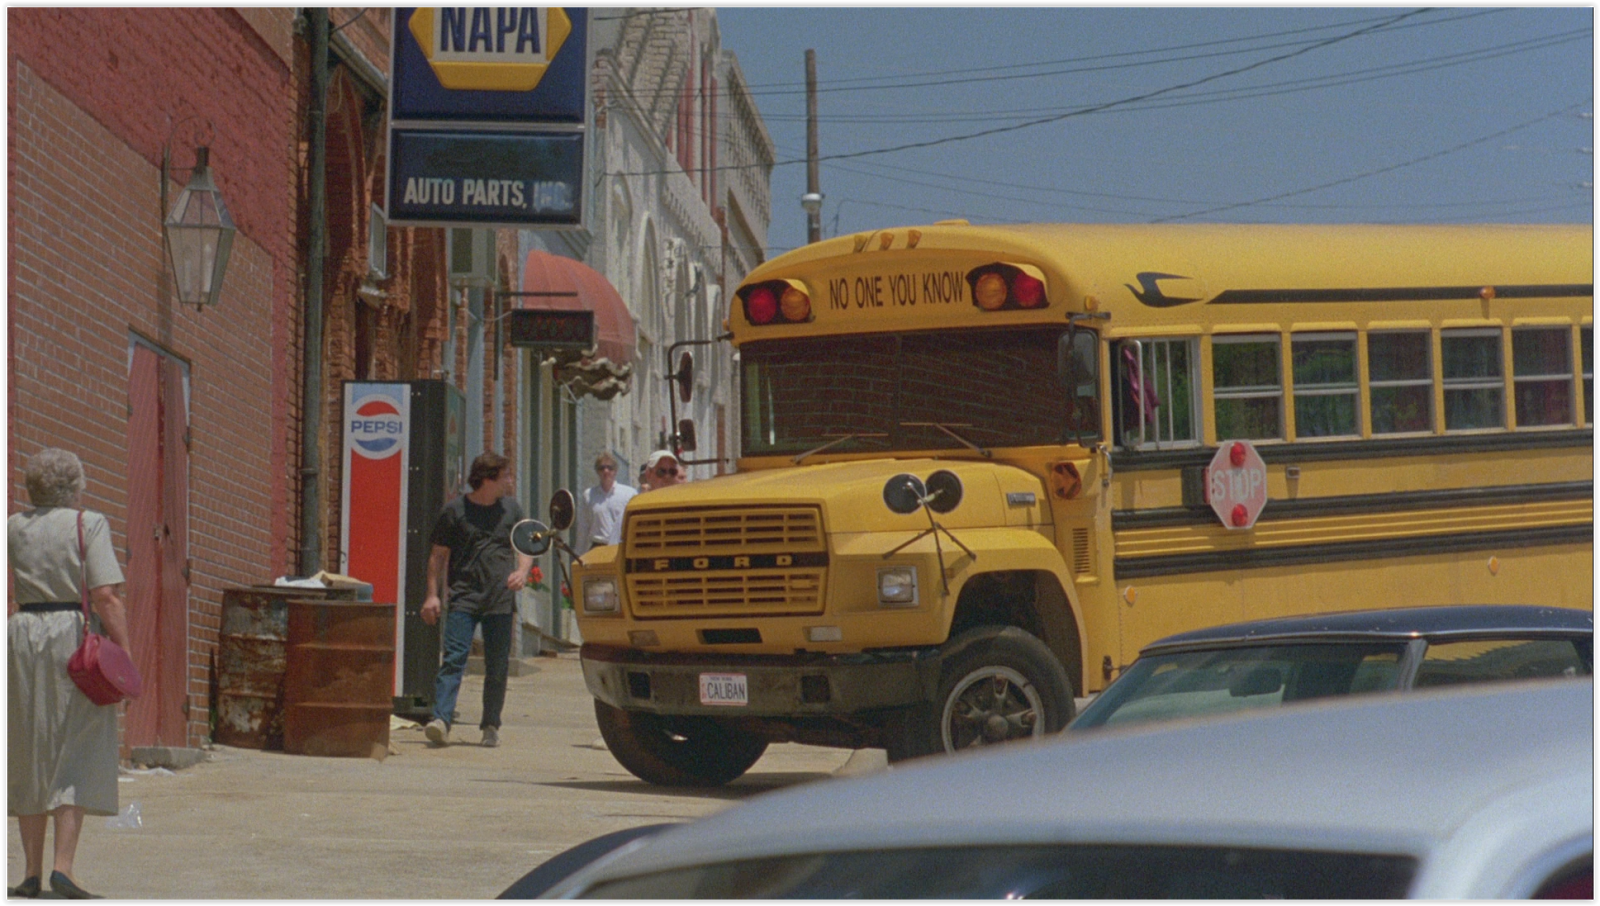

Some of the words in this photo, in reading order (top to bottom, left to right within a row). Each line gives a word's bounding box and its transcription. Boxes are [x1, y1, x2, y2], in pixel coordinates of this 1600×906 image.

[440, 7, 541, 54] NAPA
[403, 177, 455, 205] AUTO
[462, 179, 528, 209] PARTS,
[829, 278, 849, 310] NO
[855, 276, 884, 309] ONE
[888, 274, 917, 306] YOU
[922, 271, 964, 304] KNOW
[351, 421, 403, 434] PEPSI
[1214, 468, 1262, 501] STOP
[654, 555, 792, 570] FORD
[707, 682, 746, 700] CALIBAN
